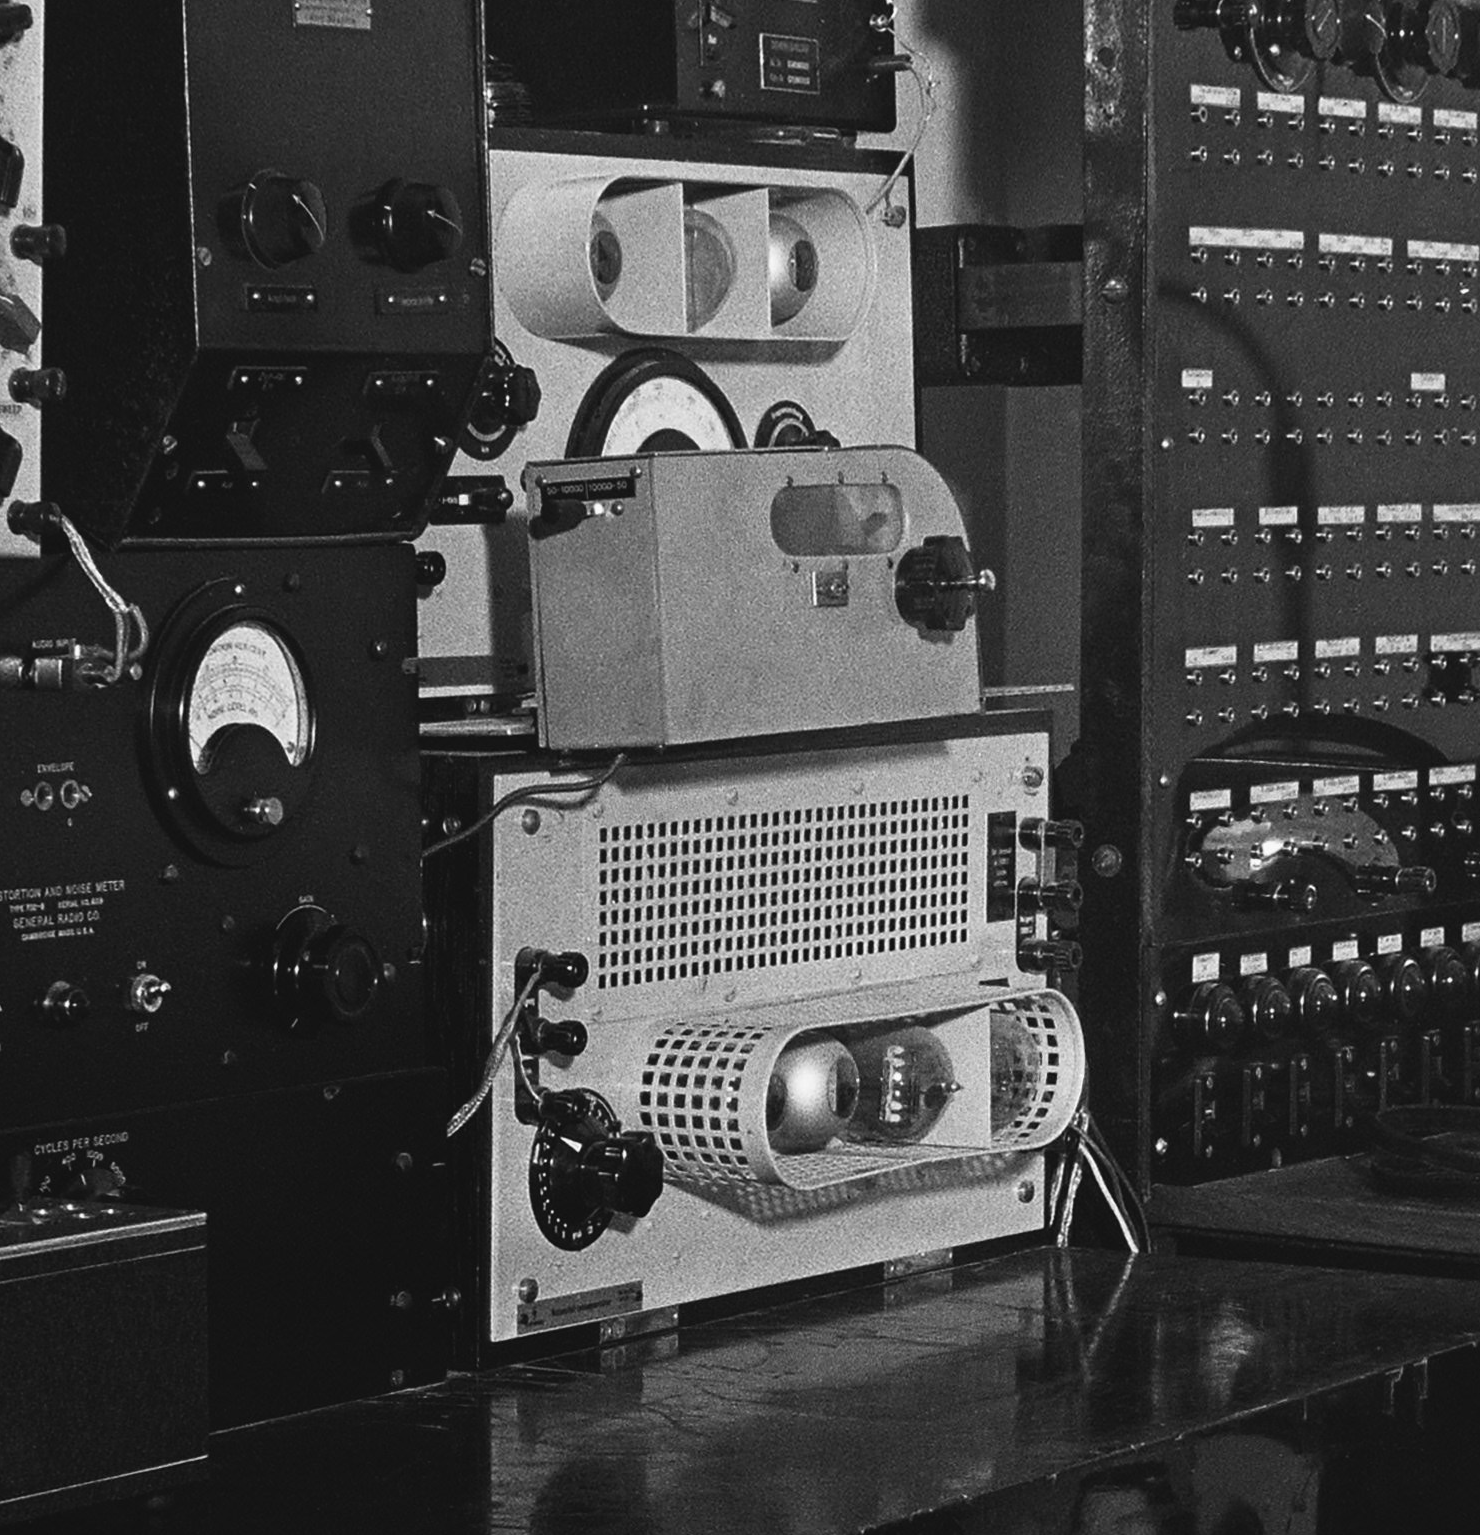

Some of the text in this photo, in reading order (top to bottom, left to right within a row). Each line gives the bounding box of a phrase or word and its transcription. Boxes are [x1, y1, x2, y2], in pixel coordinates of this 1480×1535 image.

[37, 761, 75, 773] ENVELOPE
[44, 885, 62, 898] AND
[66, 882, 92, 895] NOISE
[95, 879, 125, 892] METER
[13, 915, 54, 929] GENERAL
[57, 911, 84, 924] RADIO
[34, 1131, 129, 1155] CYCLES PER SECOND
